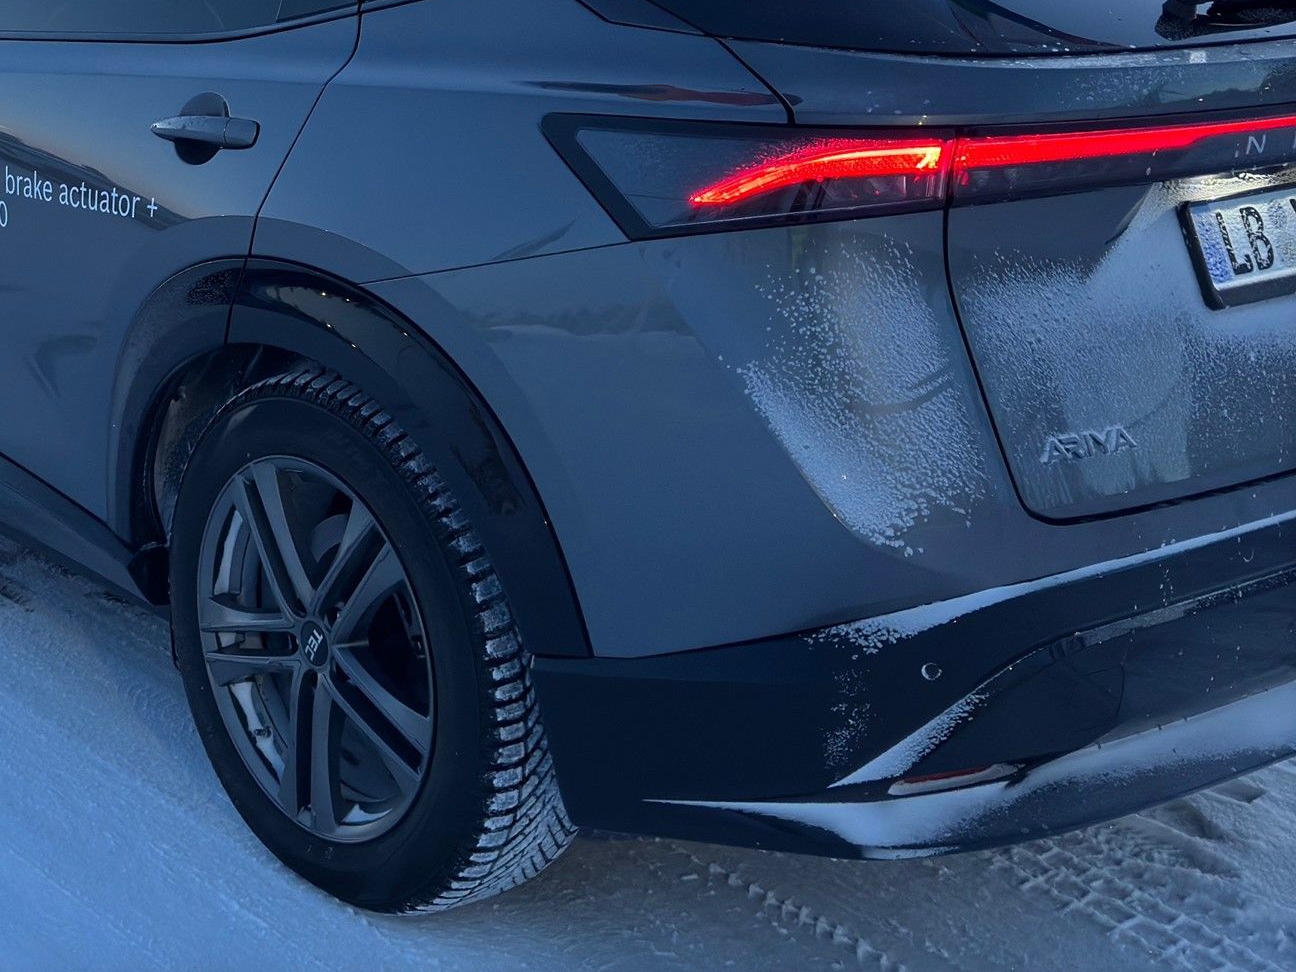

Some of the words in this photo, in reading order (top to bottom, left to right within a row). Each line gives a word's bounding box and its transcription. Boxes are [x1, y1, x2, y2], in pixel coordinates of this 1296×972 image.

[5, 165, 53, 202] brake
[58, 181, 141, 218] actuator
[1215, 206, 1275, 275] LB
[1040, 426, 1138, 464] ARIYA
[304, 628, 324, 662] TEC
